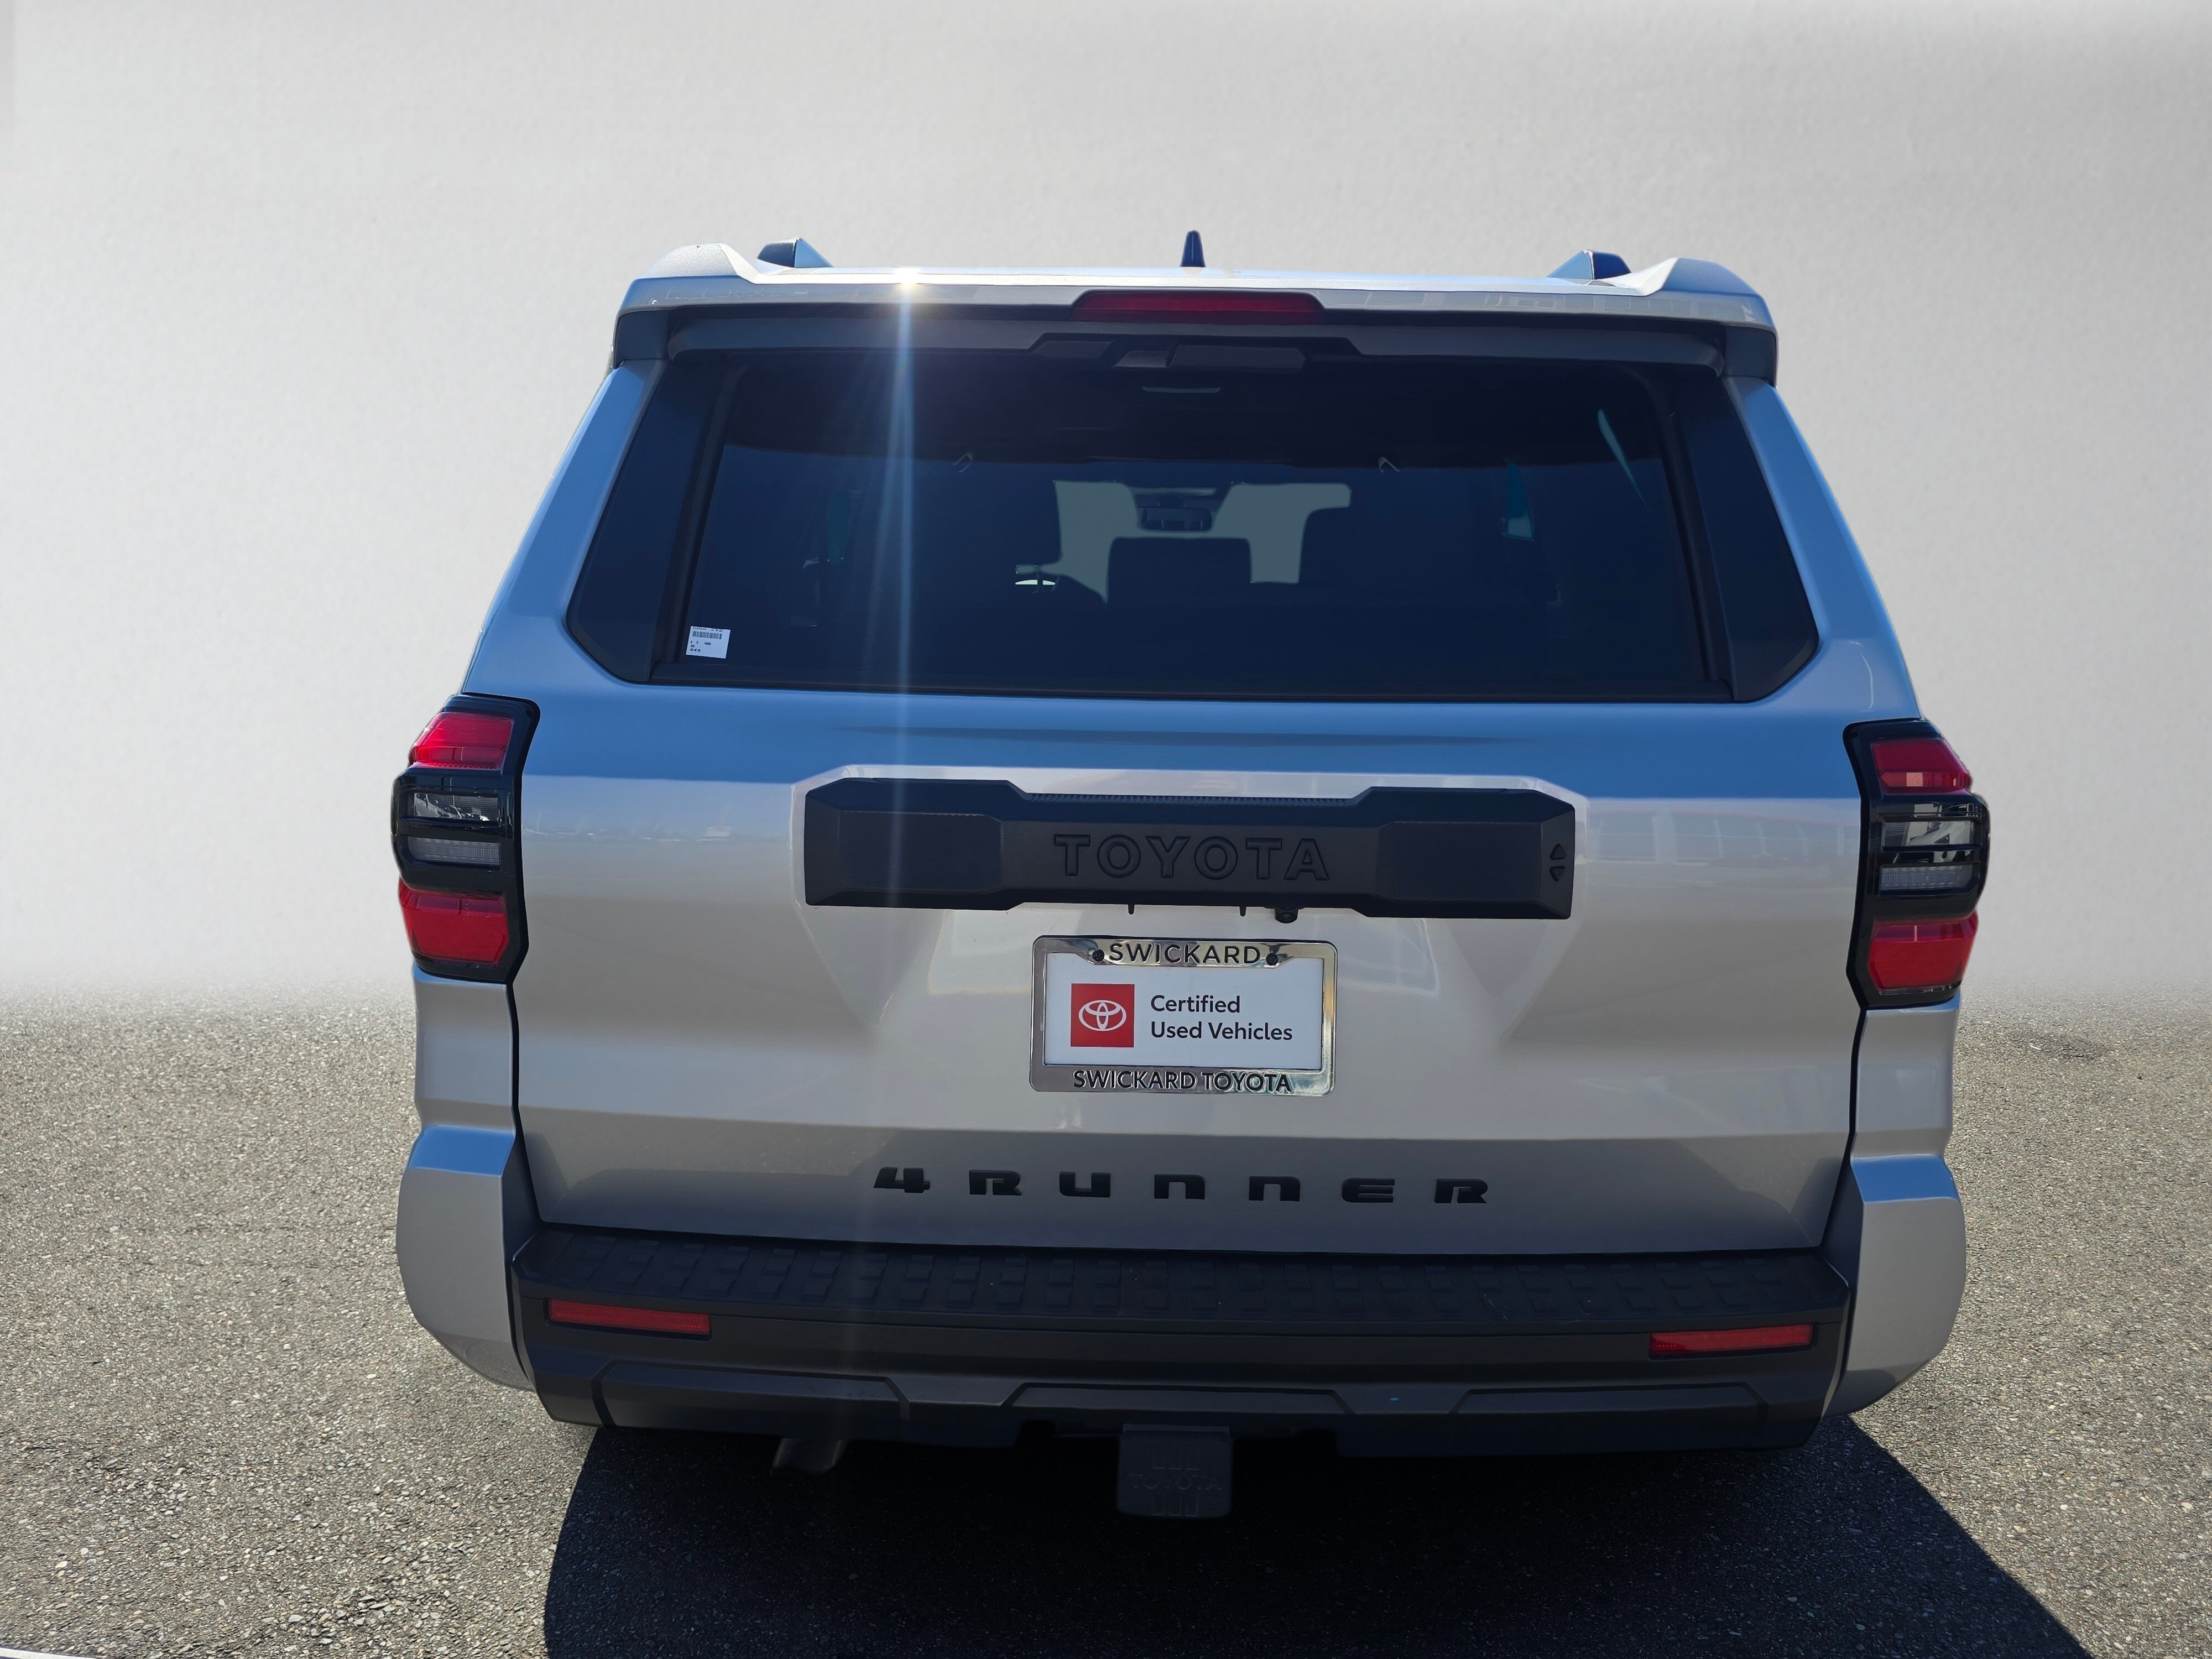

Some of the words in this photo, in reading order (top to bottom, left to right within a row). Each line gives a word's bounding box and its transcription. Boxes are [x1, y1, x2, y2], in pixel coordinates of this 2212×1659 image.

[1053, 834, 1330, 880] TOYOTA
[1109, 942, 1261, 964] SWICKARD
[1150, 995, 1241, 1013] Certified
[1151, 1021, 1202, 1039] Used
[1208, 1022, 1293, 1041] Vehicles
[1073, 1070, 1199, 1090] SWICKARD
[1201, 1071, 1293, 1093] TOYOTA
